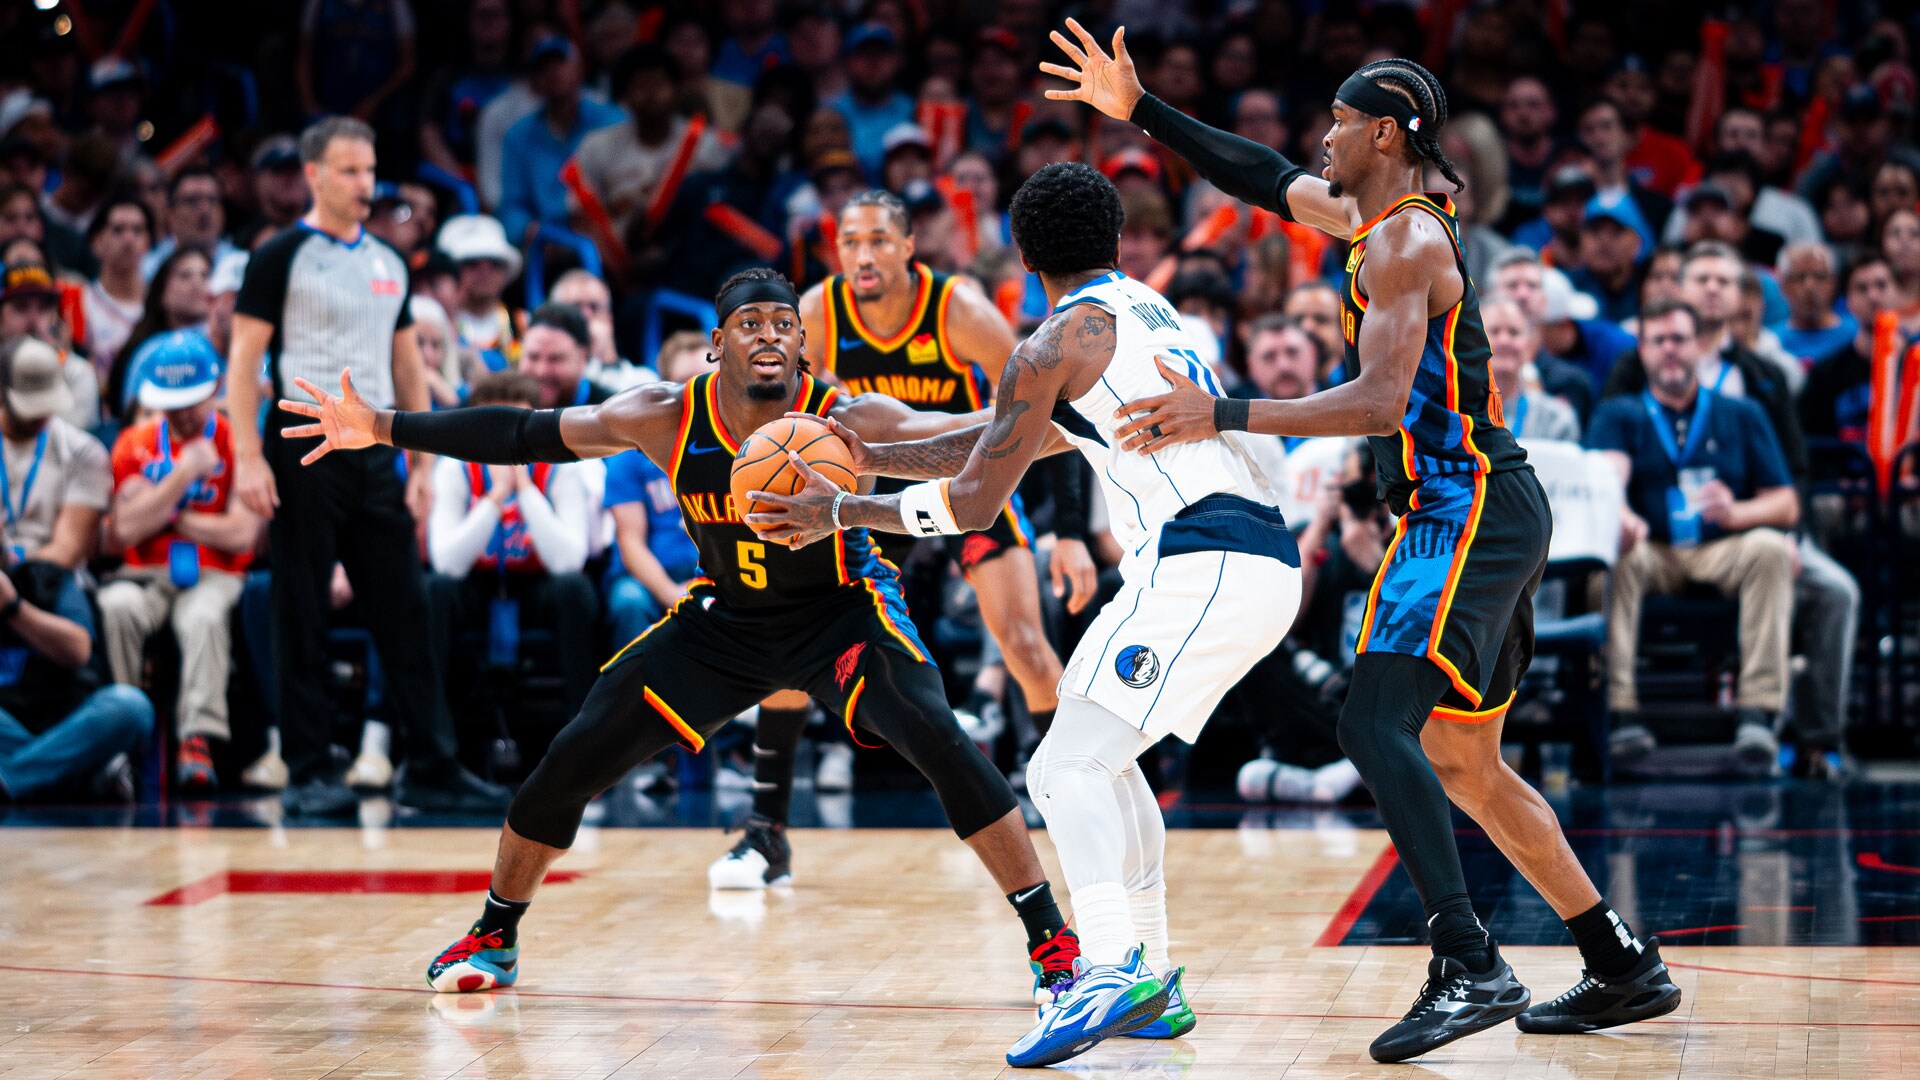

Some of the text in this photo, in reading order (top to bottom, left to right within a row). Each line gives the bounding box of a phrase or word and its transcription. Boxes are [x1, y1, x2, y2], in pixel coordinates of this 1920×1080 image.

[1128, 303, 1182, 332] IRVING
[1167, 349, 1221, 397] 11
[680, 492, 745, 525] OKLA
[736, 540, 768, 589] 5
